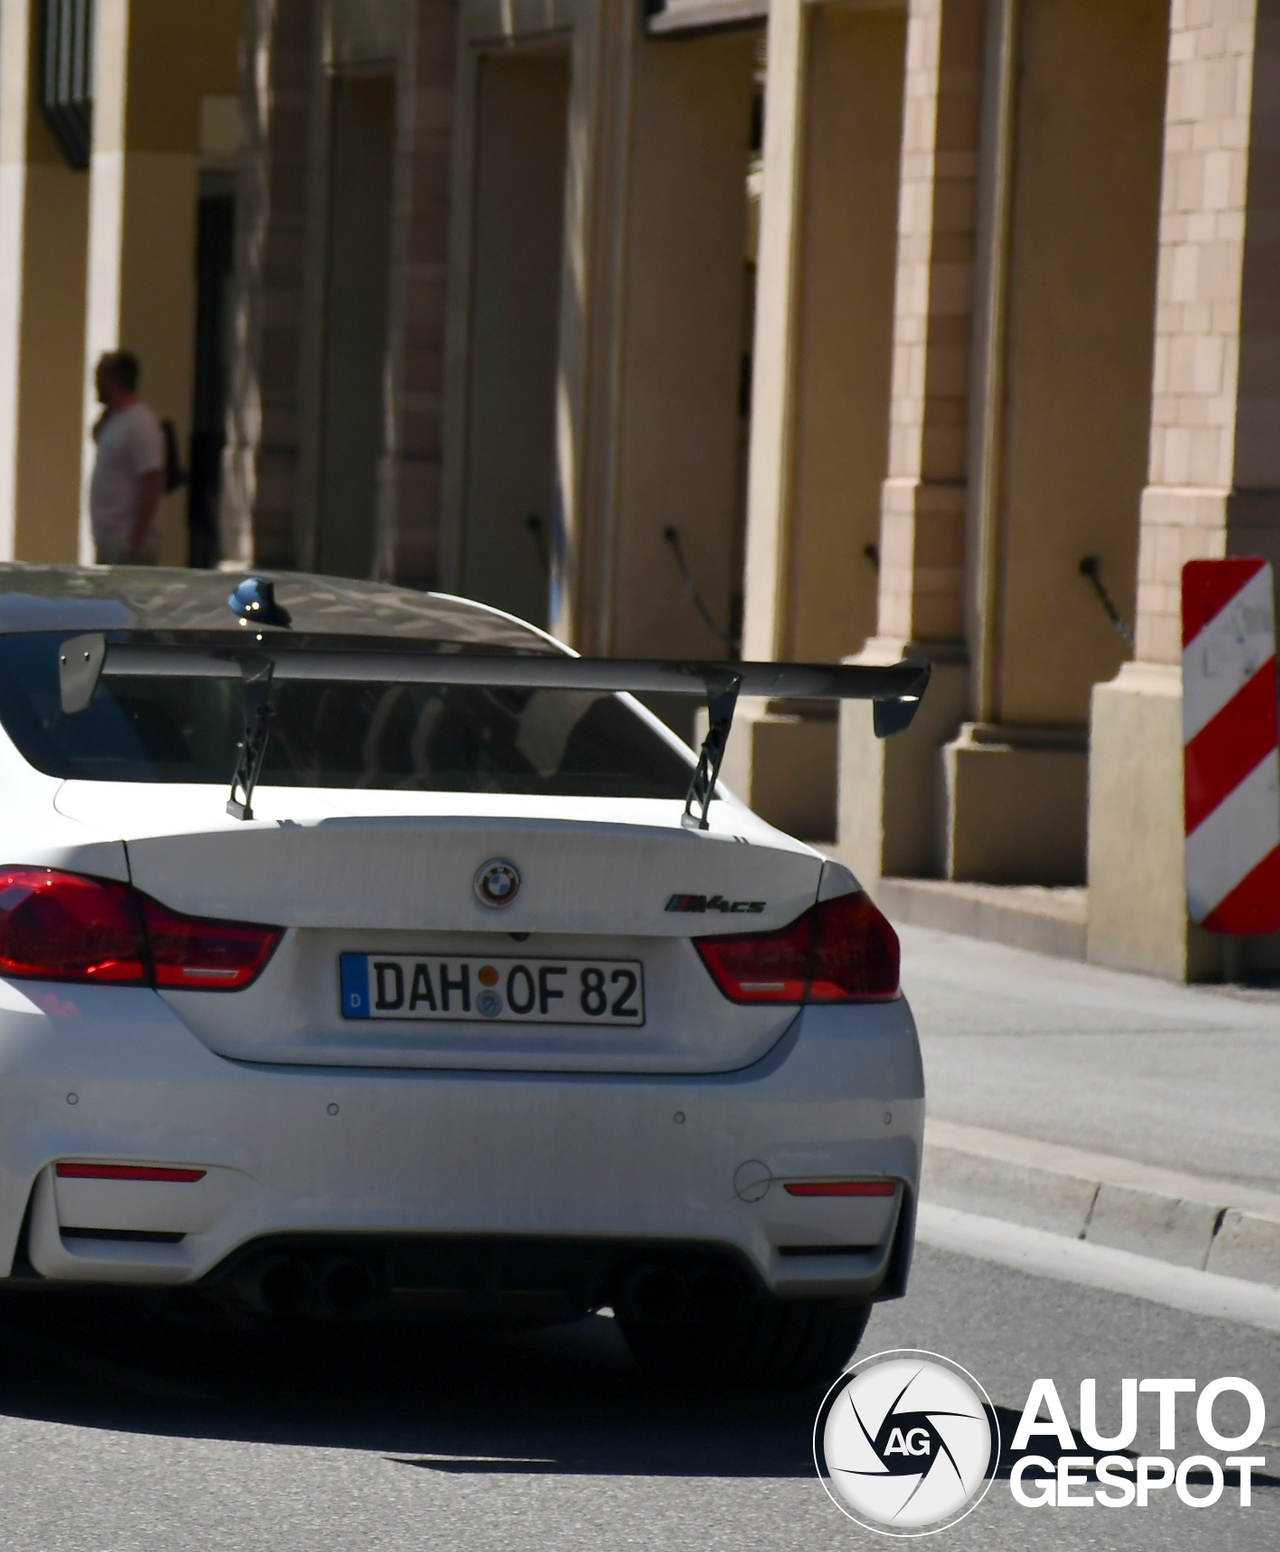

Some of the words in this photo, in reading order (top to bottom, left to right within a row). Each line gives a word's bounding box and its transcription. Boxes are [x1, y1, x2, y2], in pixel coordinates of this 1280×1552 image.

[350, 993, 361, 1008] D
[373, 962, 471, 1012] DAH
[506, 965, 568, 1016] OF
[580, 967, 639, 1018] 82
